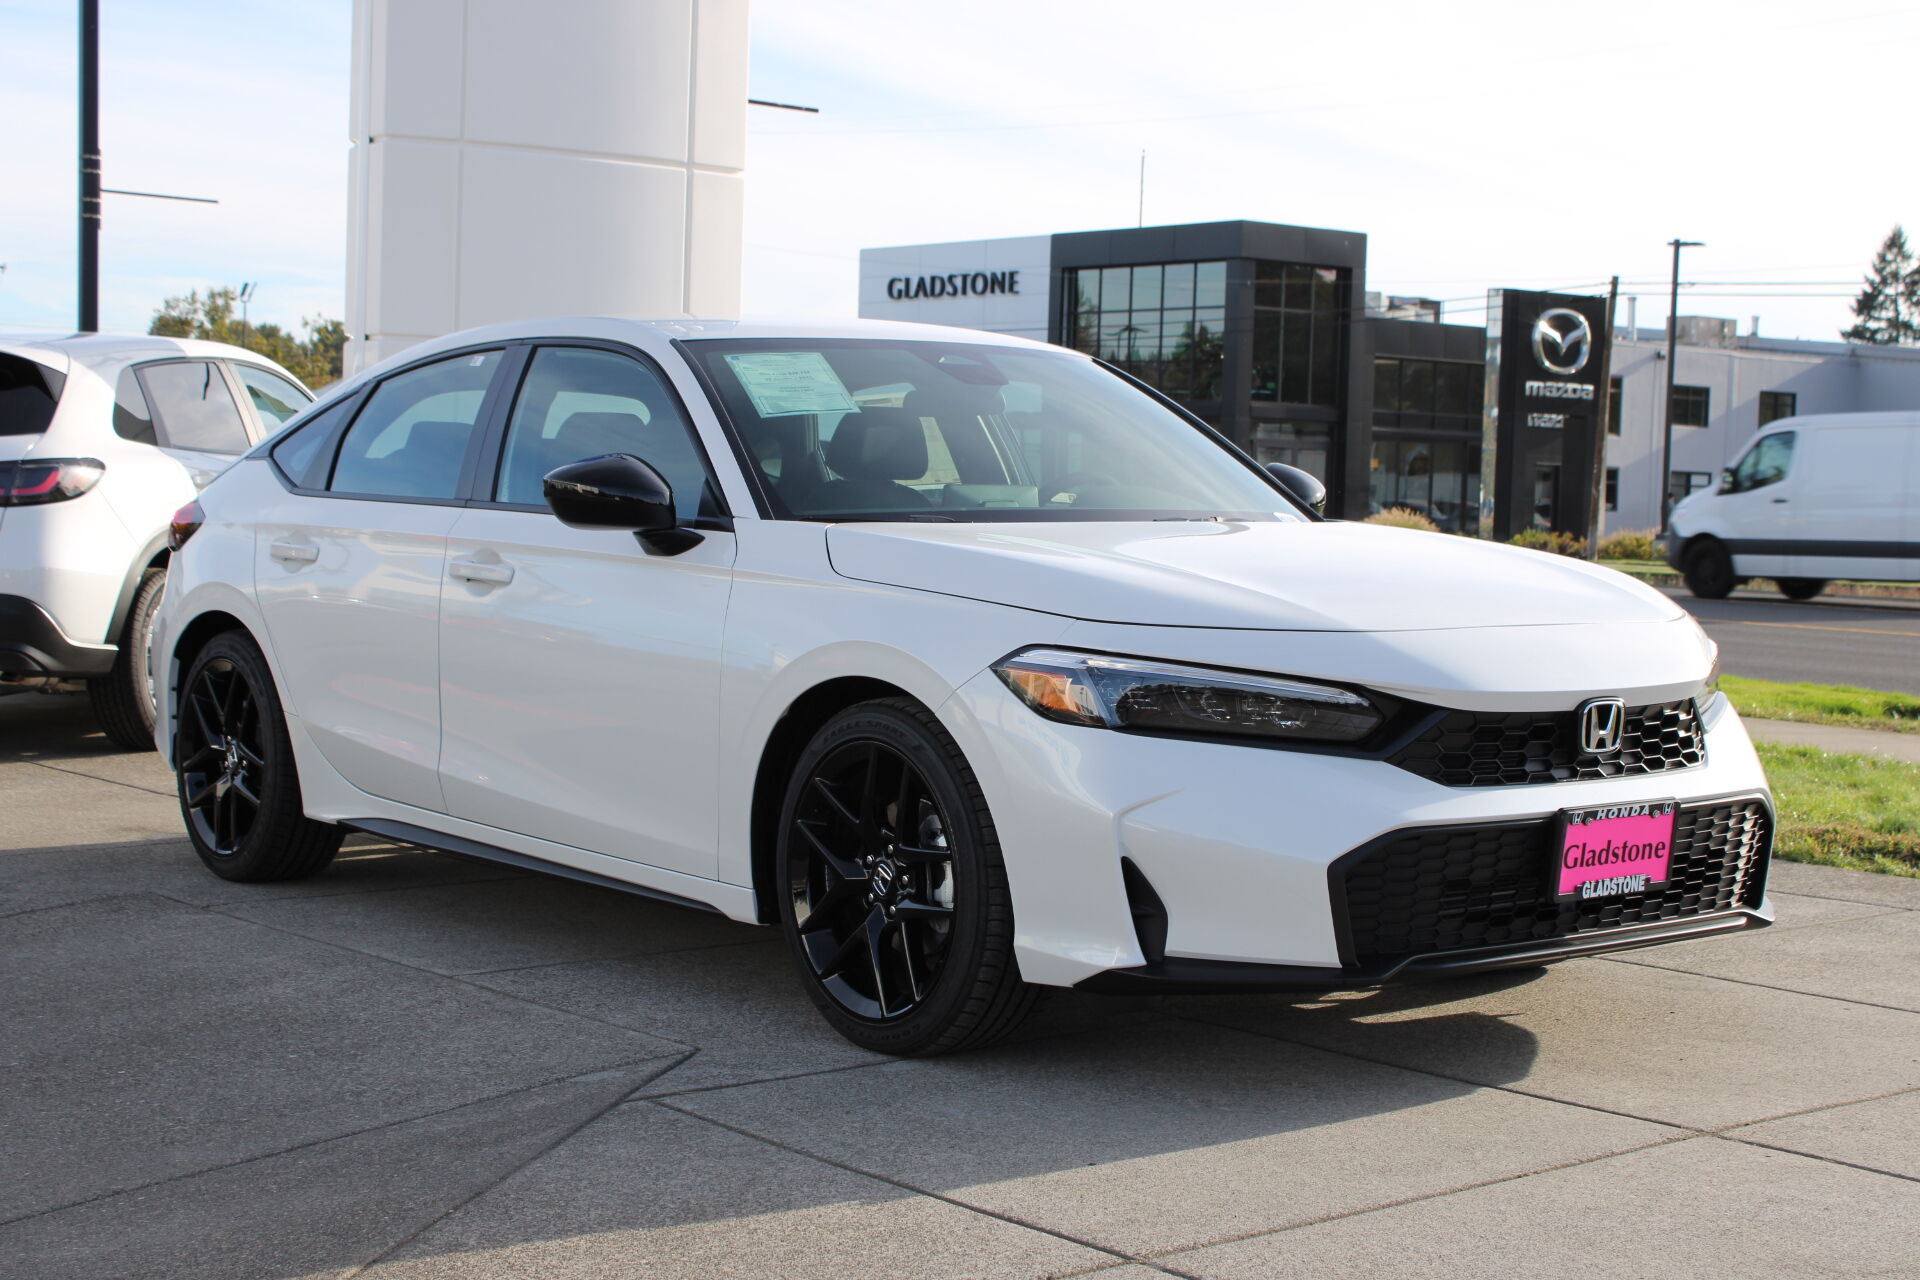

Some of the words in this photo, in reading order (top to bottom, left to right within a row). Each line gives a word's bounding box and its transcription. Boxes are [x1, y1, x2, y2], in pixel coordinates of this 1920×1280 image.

[888, 270, 1020, 300] GLADSTONE
[1596, 804, 1650, 820] HONDA
[1563, 840, 1666, 869] Gladstone
[1582, 874, 1646, 899] GLADSTONE
